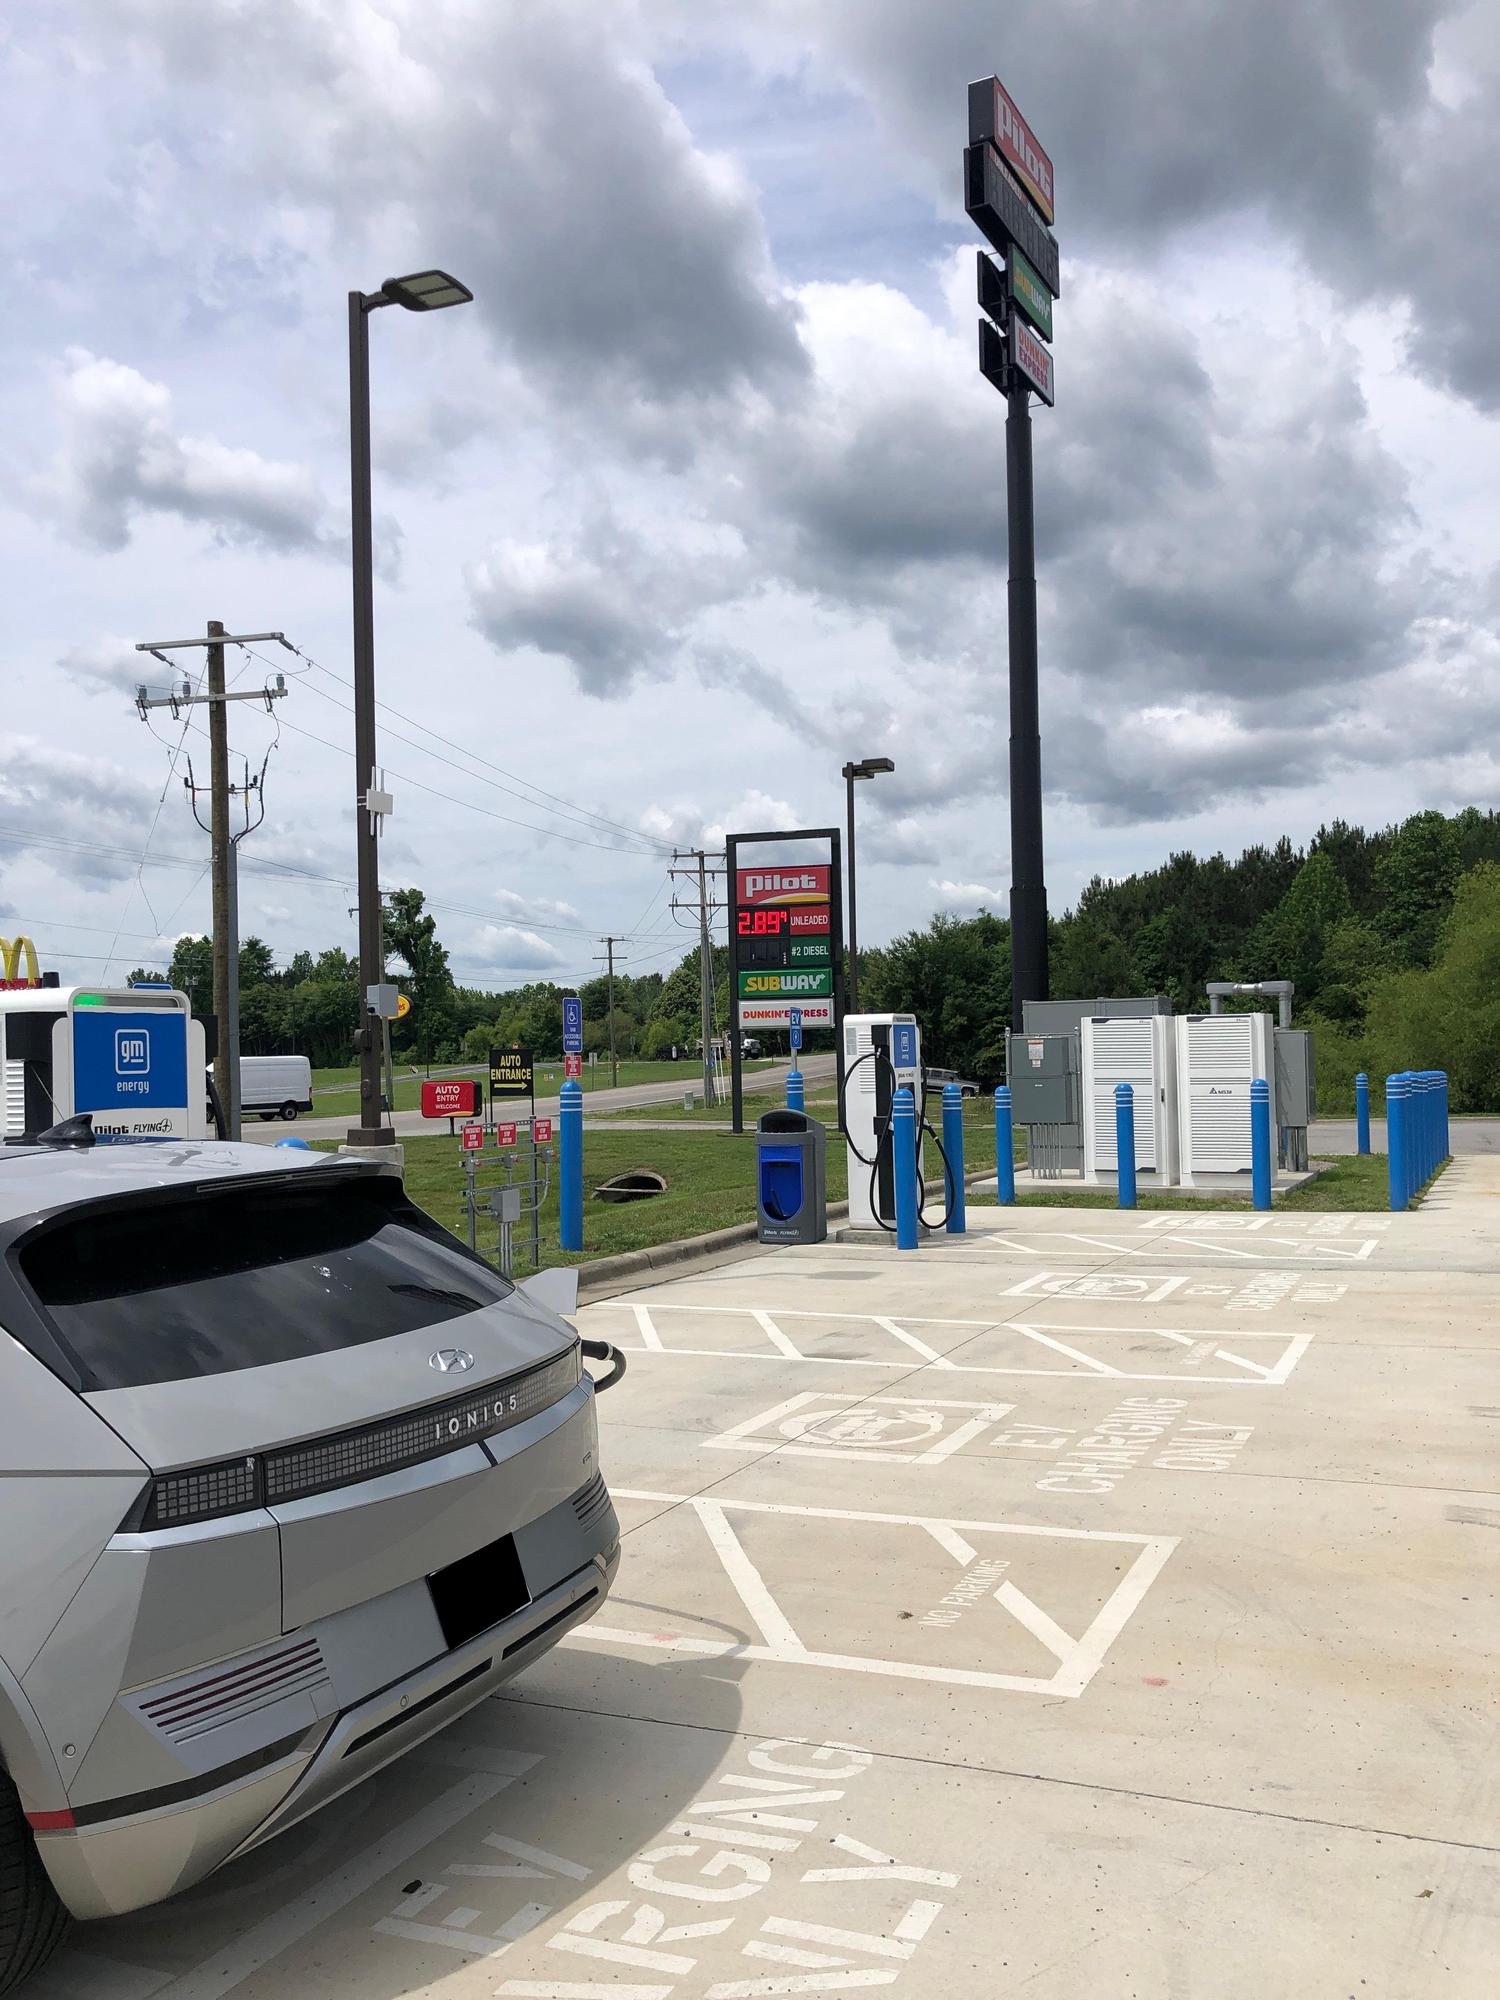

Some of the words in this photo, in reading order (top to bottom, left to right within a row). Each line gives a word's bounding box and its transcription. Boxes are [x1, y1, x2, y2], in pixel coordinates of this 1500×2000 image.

[790, 915, 828, 926] UNLEADED
[791, 946, 801, 956] #2
[803, 946, 829, 956] DIESEL
[744, 974, 826, 992] SUBWAY
[785, 1008, 829, 1018] ERESS
[121, 1040, 144, 1063] gm
[500, 1055, 521, 1067] AUTO
[490, 1068, 532, 1080] ENTRANCE
[116, 1081, 150, 1094] energy
[435, 1085, 460, 1095] AUTO
[436, 1094, 460, 1102] ENTRY
[133, 1122, 162, 1133] FLYING
[435, 1401, 504, 1440] IONIQ
[509, 1394, 517, 1411] 5
[989, 1423, 1077, 1450] EV
[1035, 1397, 1188, 1494] CHARGING
[1152, 1419, 1255, 1472] ONLY
[938, 1559, 1011, 1607] PARKING
[917, 1610, 962, 1628] NO
[494, 1737, 875, 2000] RGING
[371, 1831, 594, 1957] EV
[703, 1833, 962, 2000] NLY
